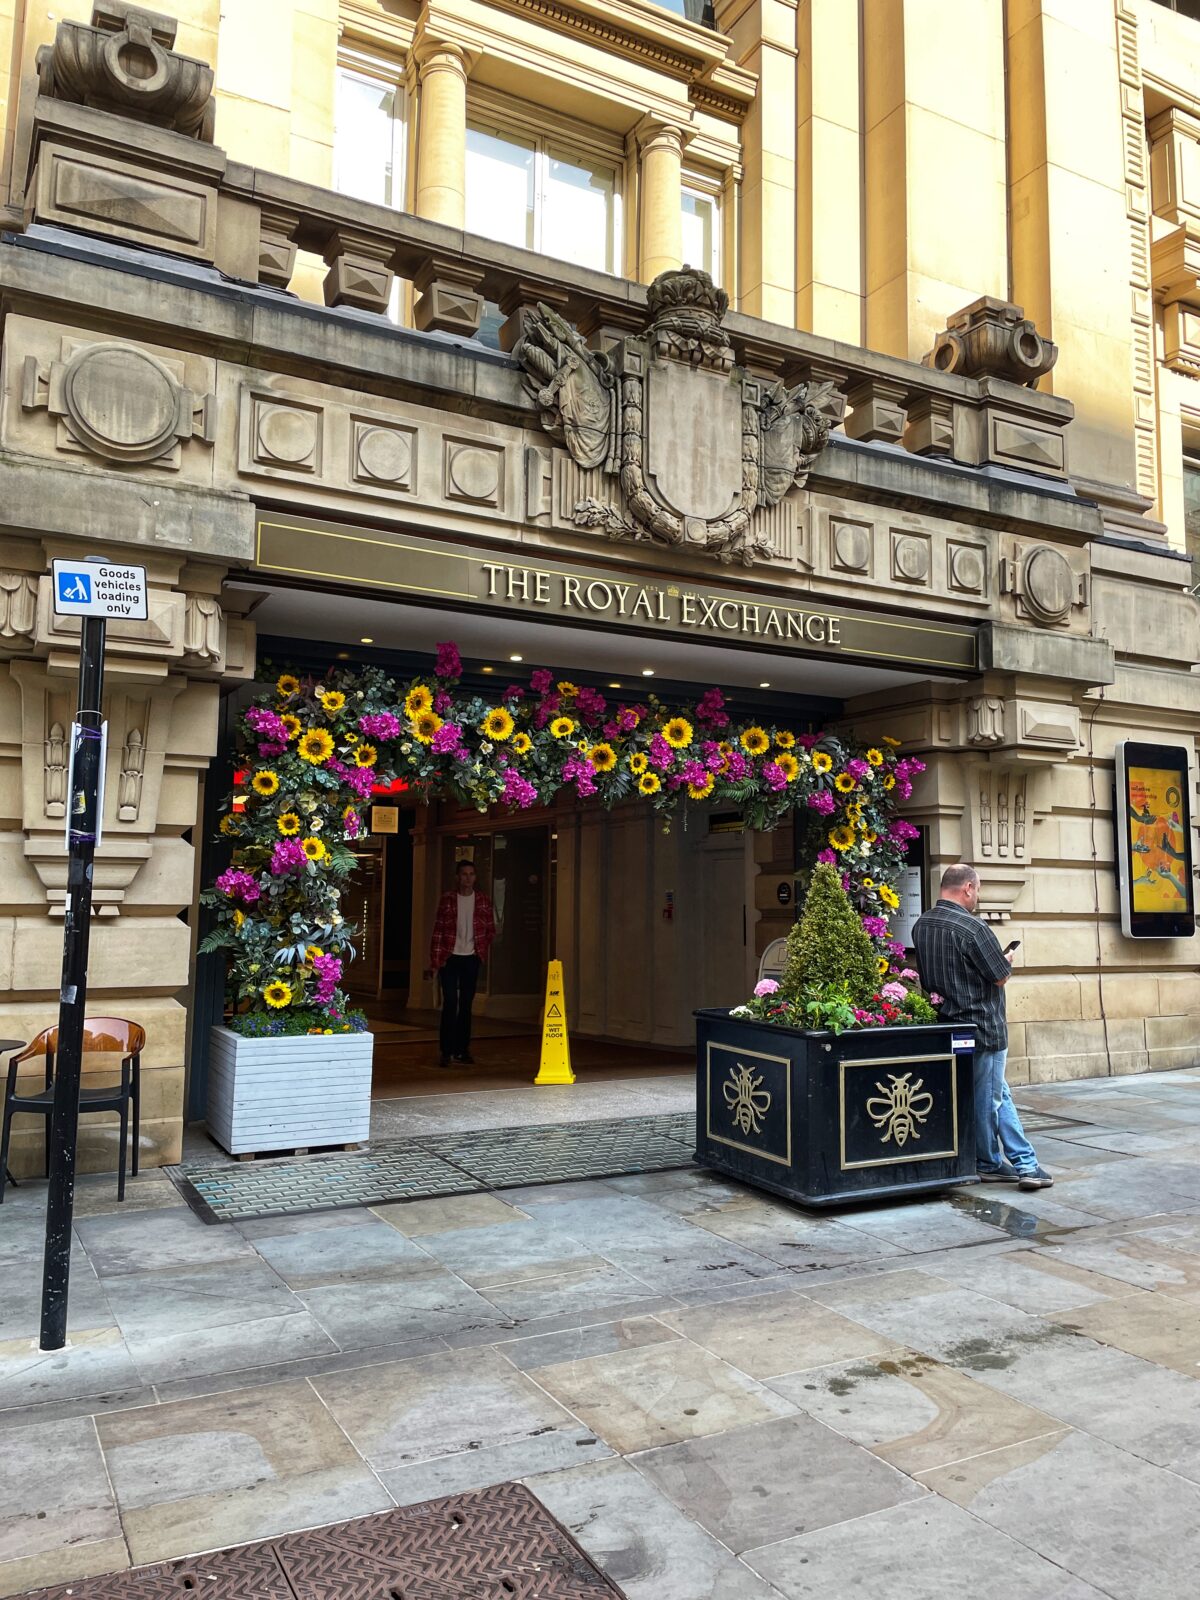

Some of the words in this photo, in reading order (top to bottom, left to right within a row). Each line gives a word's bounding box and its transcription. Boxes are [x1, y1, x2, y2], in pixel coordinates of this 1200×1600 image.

[99, 568, 136, 579] Goods
[94, 580, 141, 591] vehicles
[97, 591, 139, 604] loading
[106, 604, 131, 615] only
[482, 564, 551, 604] THE
[563, 575, 671, 621] ROYAL
[681, 594, 842, 645] EXCHANGE
